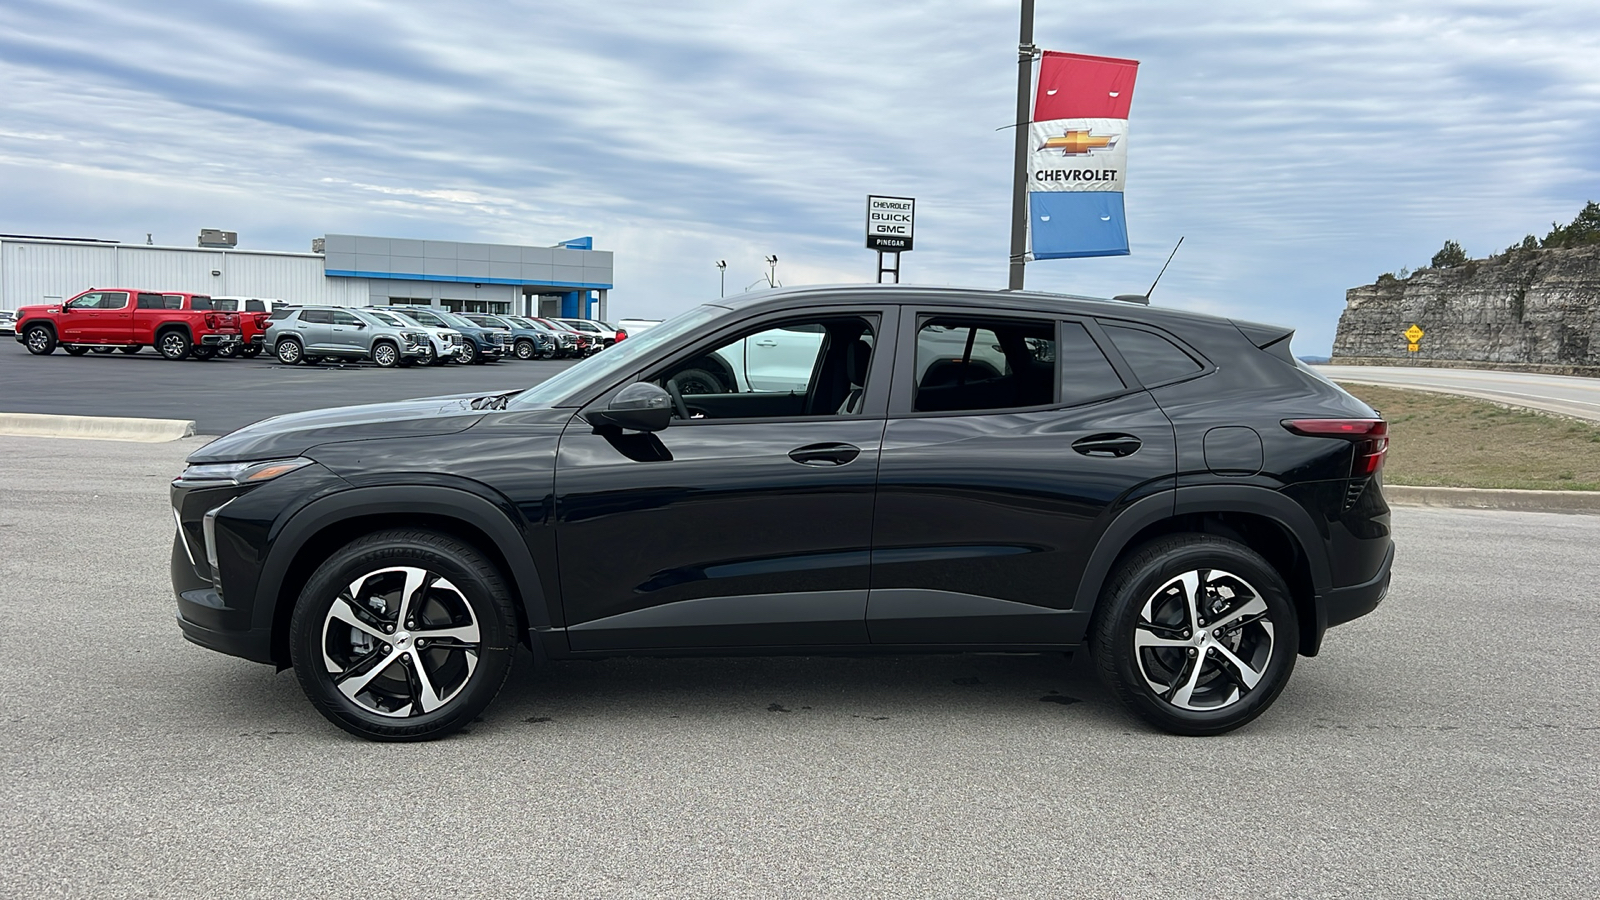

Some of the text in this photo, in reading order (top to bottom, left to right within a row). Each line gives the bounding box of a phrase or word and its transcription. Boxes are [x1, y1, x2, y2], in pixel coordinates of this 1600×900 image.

[1035, 169, 1117, 182] CHEVROLET
[873, 201, 911, 210] CHEVROLET
[871, 212, 911, 222] BUICK
[876, 224, 906, 234] GMC
[876, 238, 905, 247] PINEGAR
